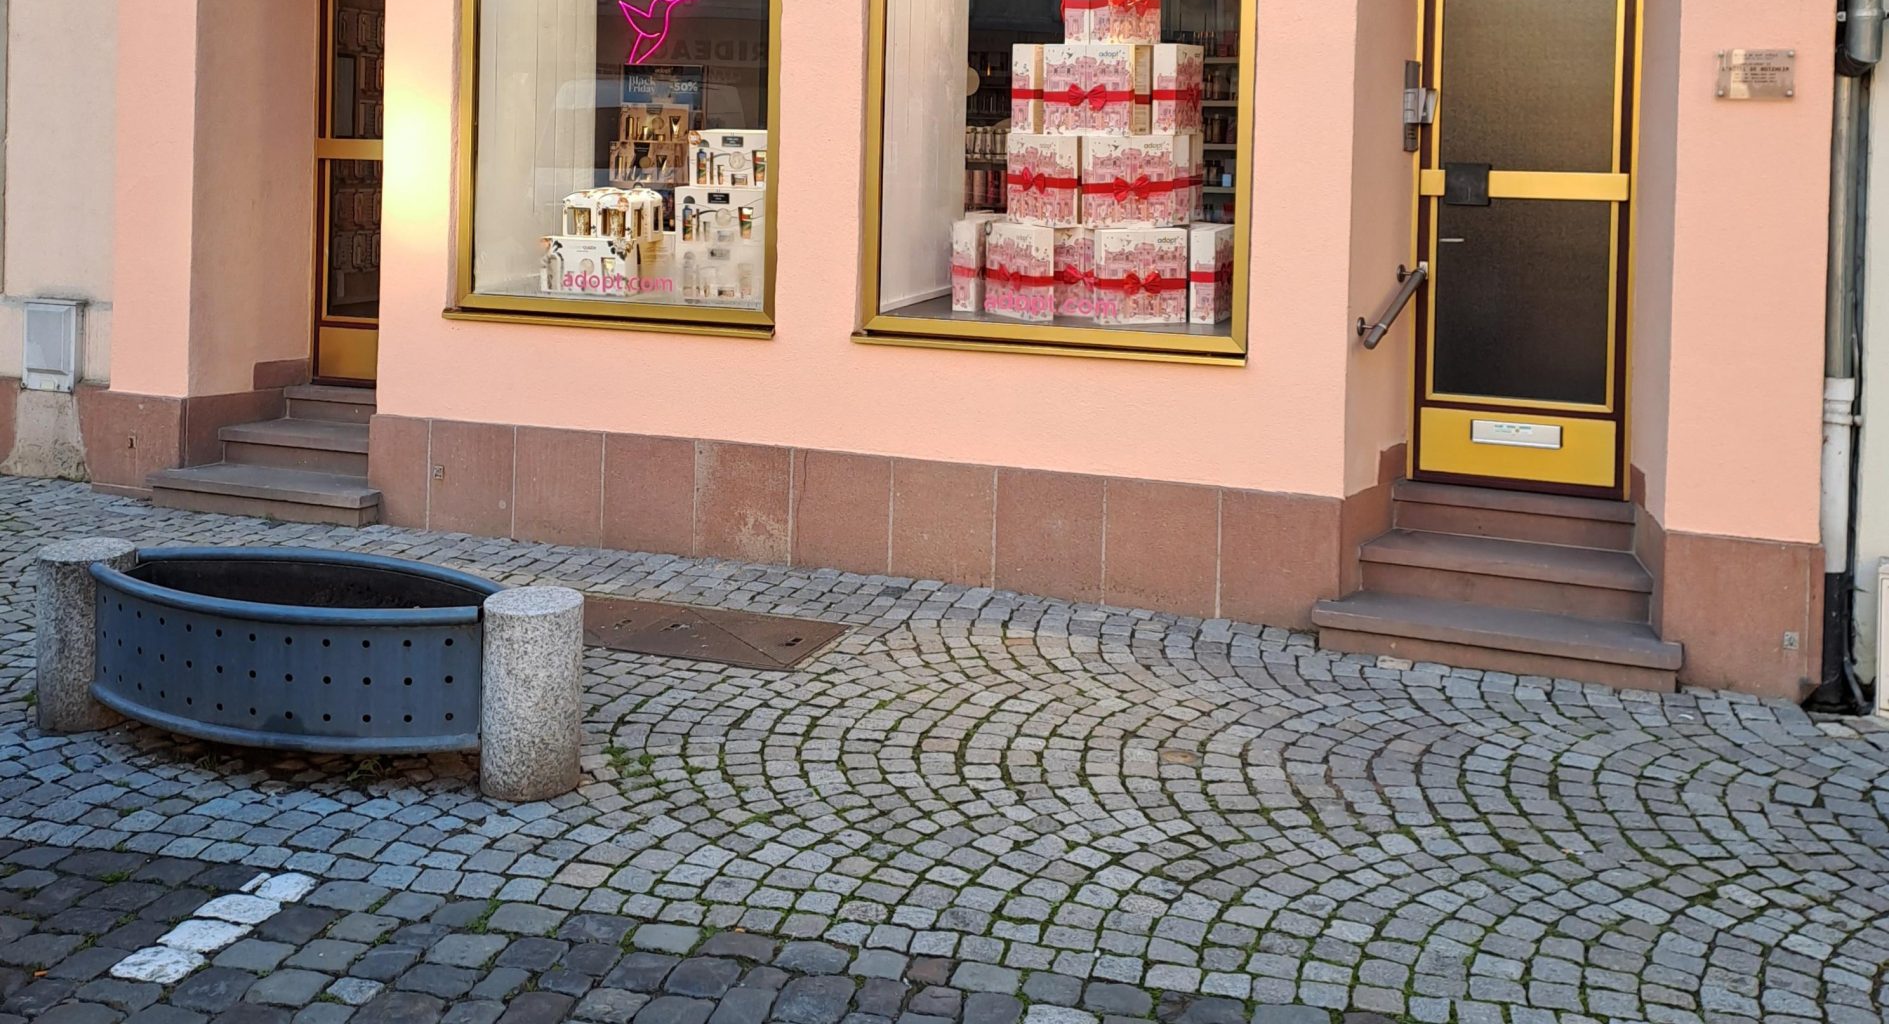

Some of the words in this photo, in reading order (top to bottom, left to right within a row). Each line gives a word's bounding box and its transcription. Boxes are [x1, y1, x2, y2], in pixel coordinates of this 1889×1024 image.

[628, 75, 656, 86] Black
[628, 83, 656, 94] Friday
[670, 81, 698, 92] -50%
